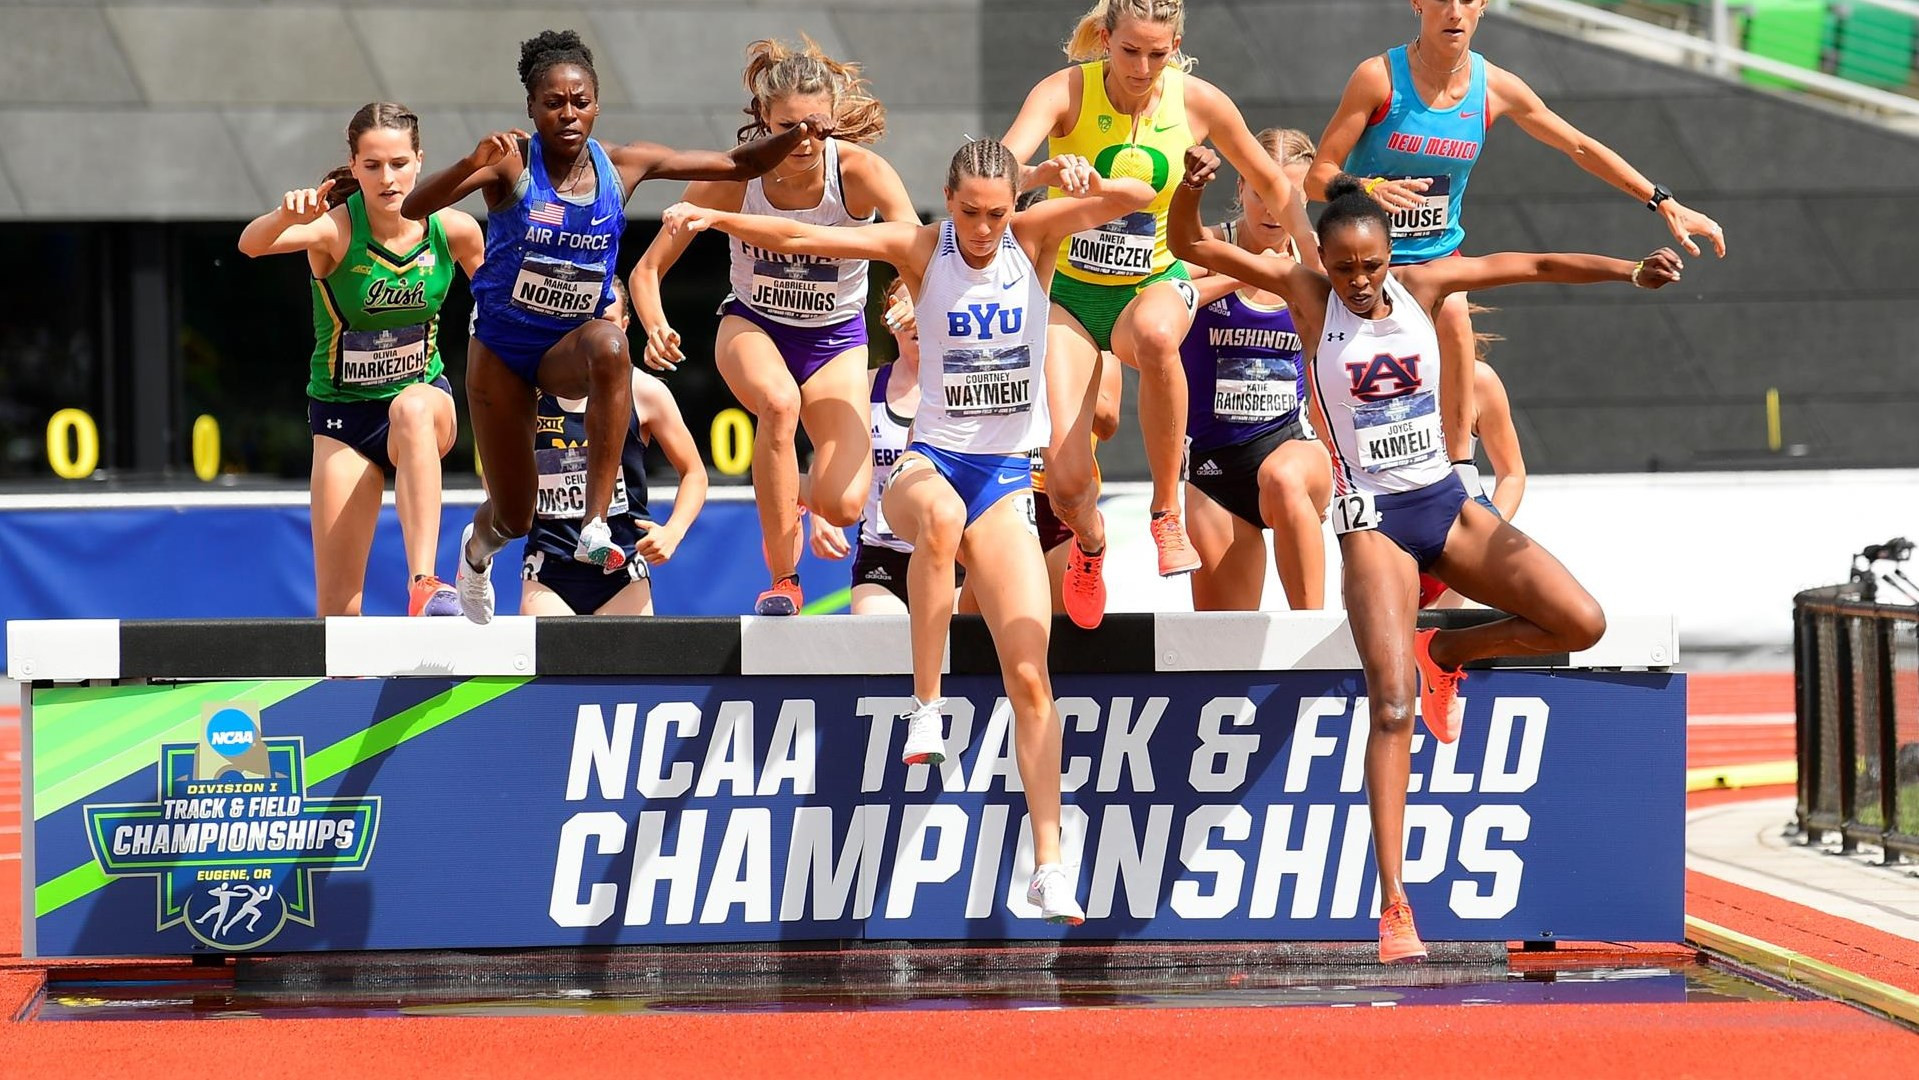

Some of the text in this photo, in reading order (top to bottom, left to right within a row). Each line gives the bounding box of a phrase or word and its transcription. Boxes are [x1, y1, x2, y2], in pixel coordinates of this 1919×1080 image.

[1387, 132, 1478, 160] NEW MEXICO
[525, 226, 612, 250] AIR FORCE
[1099, 233, 1126, 245] ANETA
[1070, 236, 1153, 269] KONIECZEK
[363, 278, 428, 312] Irish
[520, 281, 593, 311] NORRIS
[544, 278, 578, 292] MAHALA
[752, 284, 836, 312] JENNINGS
[773, 280, 818, 291] GABRIELLE
[947, 303, 1023, 340] BYU
[344, 352, 424, 379] MARKEZICH
[373, 349, 398, 360] OLIVIA
[965, 372, 1010, 384] COURTNEY
[945, 379, 1030, 407] WAYMENT
[1215, 391, 1296, 411] RAINSBERGER
[710, 407, 755, 476] 0
[1387, 421, 1413, 436] JOYCE
[46, 408, 99, 480] 0
[1368, 428, 1431, 461] KIMELI
[1196, 468, 1223, 476] adidas
[1337, 495, 1368, 531] 12
[211, 731, 254, 745] NCAA
[565, 698, 816, 801] NCAA
[855, 696, 1170, 793] TRACK
[1188, 696, 1261, 793] &
[187, 783, 278, 795] DIVISION I
[164, 795, 301, 820] TRACK & FIELD
[112, 819, 355, 856] CHAMPIONSHIPS
[197, 869, 272, 881] EUGENE, OR
[549, 803, 1531, 928] CHAMPIONSHIPS
